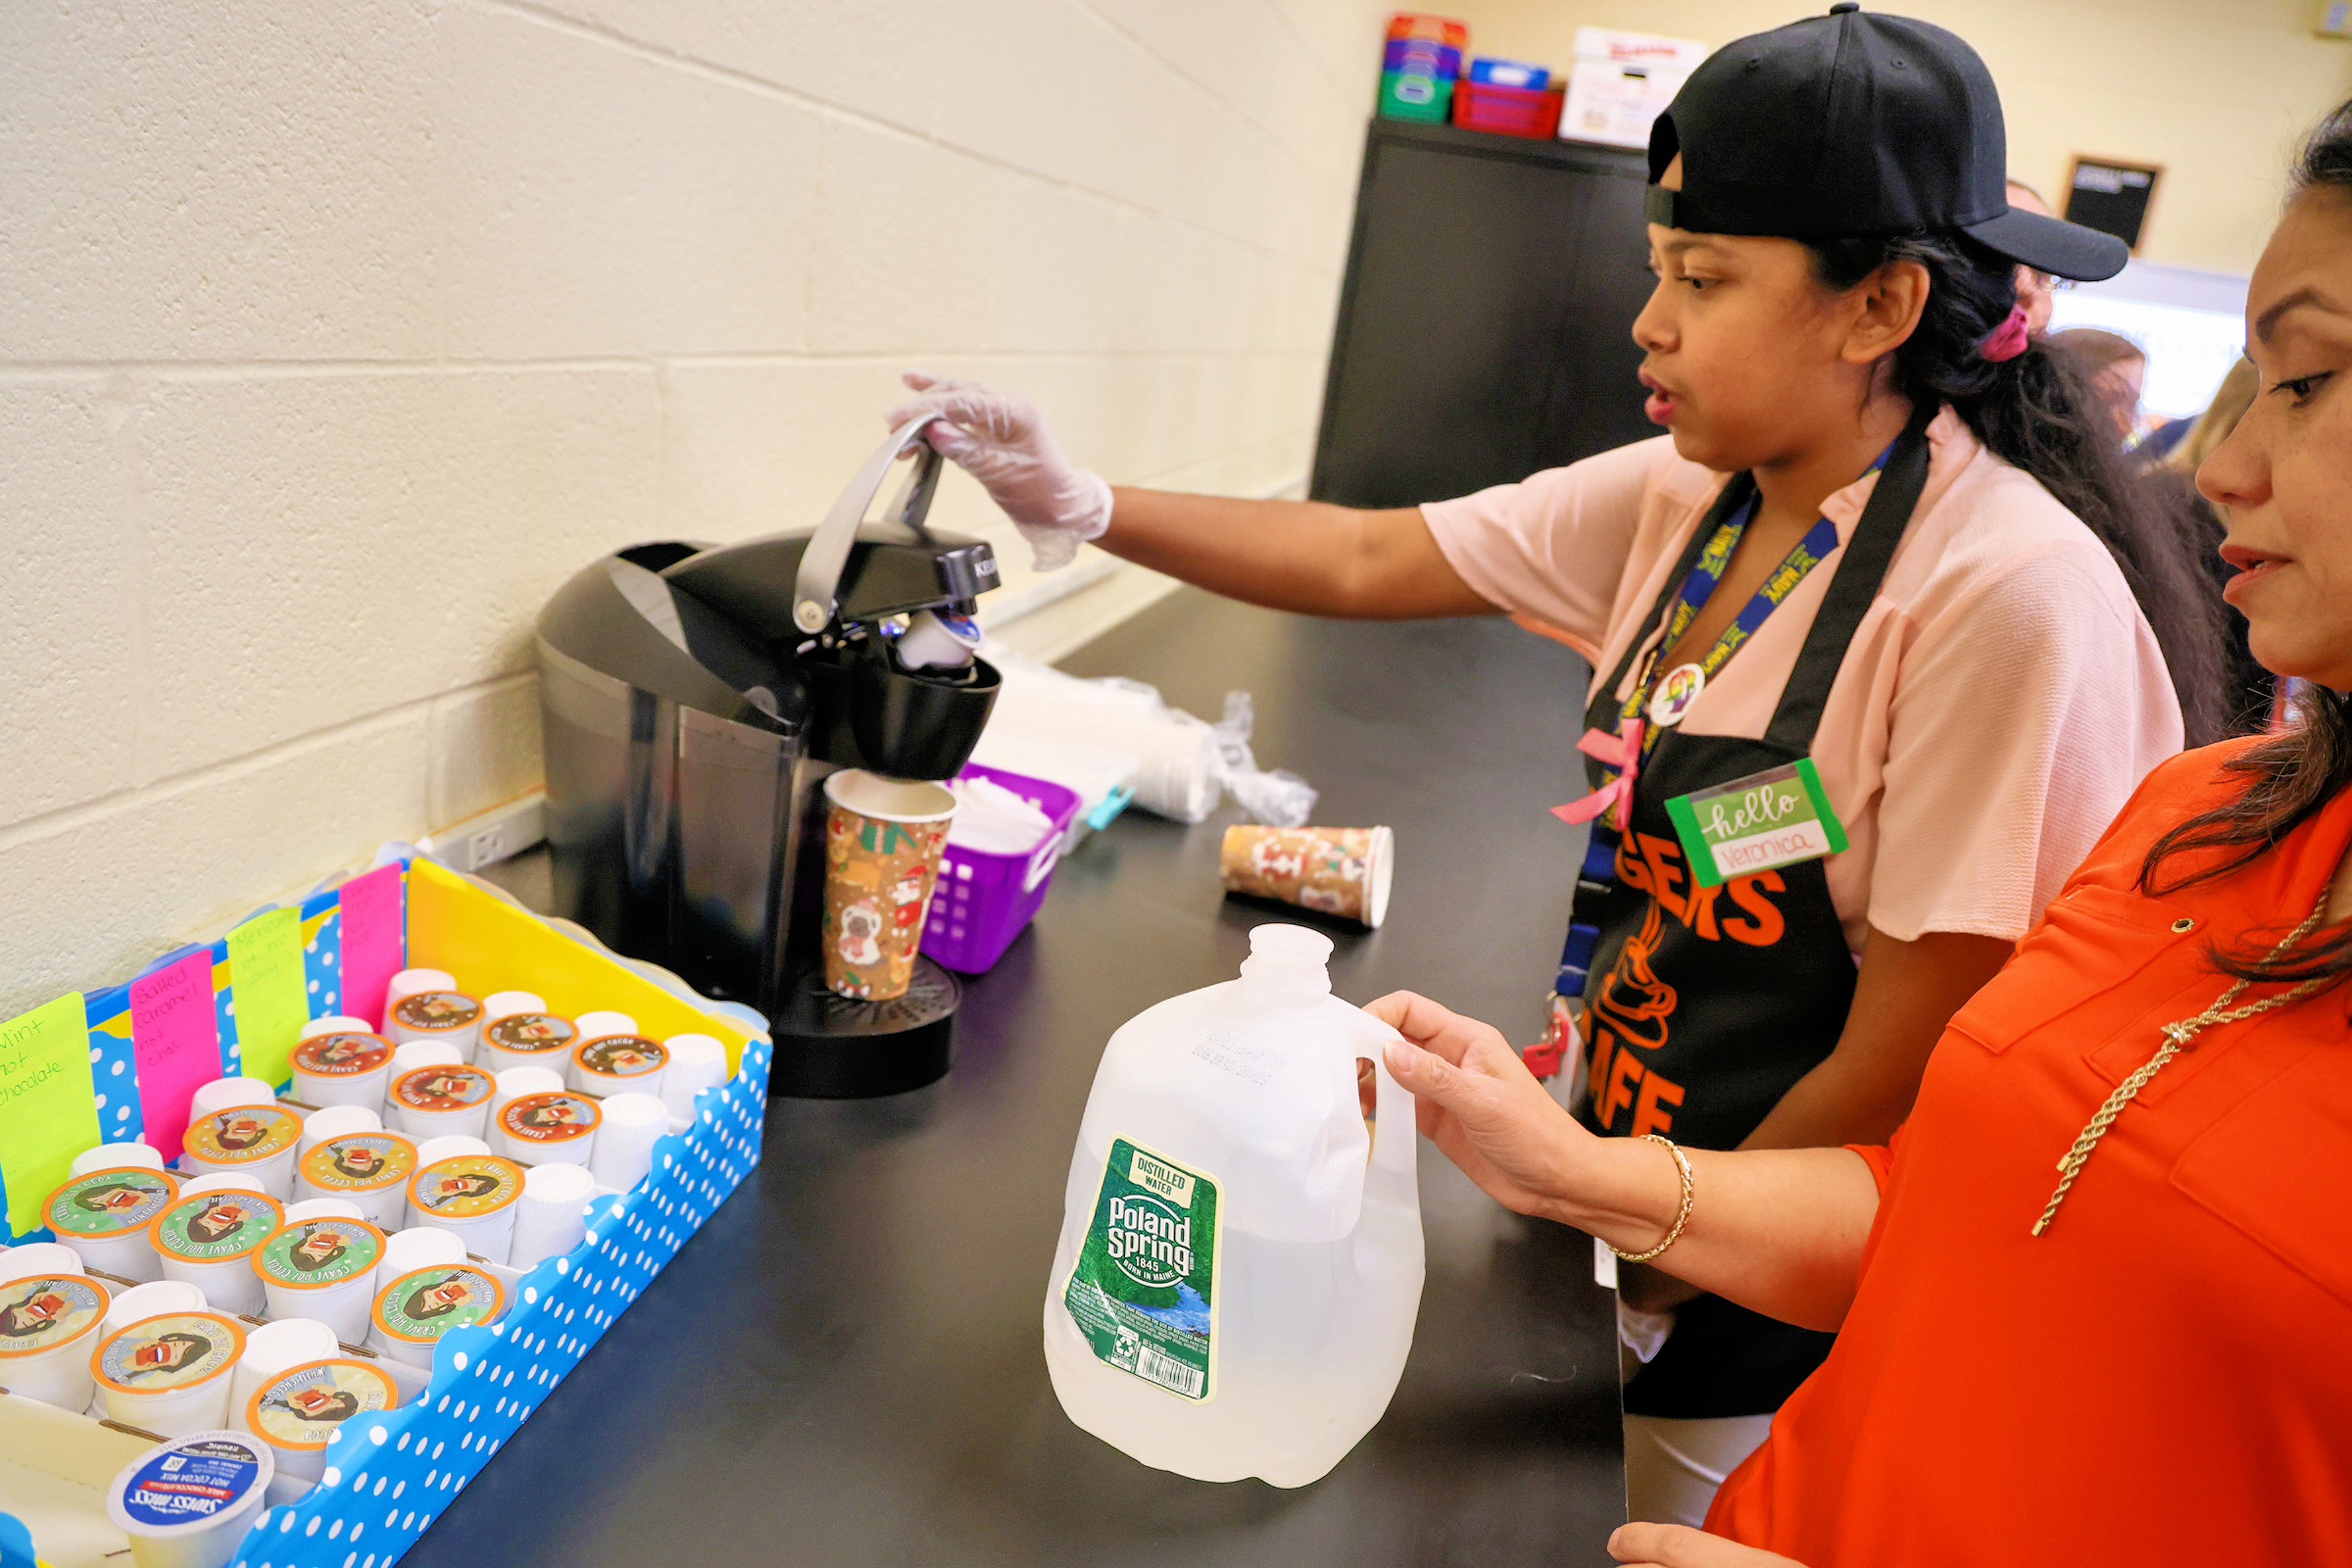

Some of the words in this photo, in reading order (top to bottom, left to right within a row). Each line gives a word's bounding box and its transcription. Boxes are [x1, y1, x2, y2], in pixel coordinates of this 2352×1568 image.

[1701, 784, 1799, 839] hello
[1721, 833, 1816, 869] Veronica
[135, 965, 186, 1004] Salted
[1583, 1007, 1686, 1139] AFE
[1137, 1157, 1186, 1190] DISTILLED
[1145, 1176, 1172, 1196] WATER
[1108, 1197, 1191, 1250] Poland
[183, 1243, 205, 1255] HOT
[207, 1243, 243, 1259] CRAVE
[1107, 1227, 1191, 1276] Spring
[1123, 1259, 1142, 1277] BORN
[1143, 1269, 1152, 1280] IN
[1152, 1270, 1176, 1281] MAINE
[1136, 1256, 1159, 1272] 1845
[291, 1270, 313, 1281] HOT
[315, 1267, 350, 1282] CRAVE
[389, 1311, 409, 1330] HOT
[405, 1321, 435, 1337] CRAVE
[1173, 1328, 1194, 1340] DISTILLED
[1194, 1336, 1208, 1346] WATER
[180, 1474, 210, 1486] COCOA
[211, 1478, 231, 1487] HOT
[209, 1486, 227, 1495] MILK
